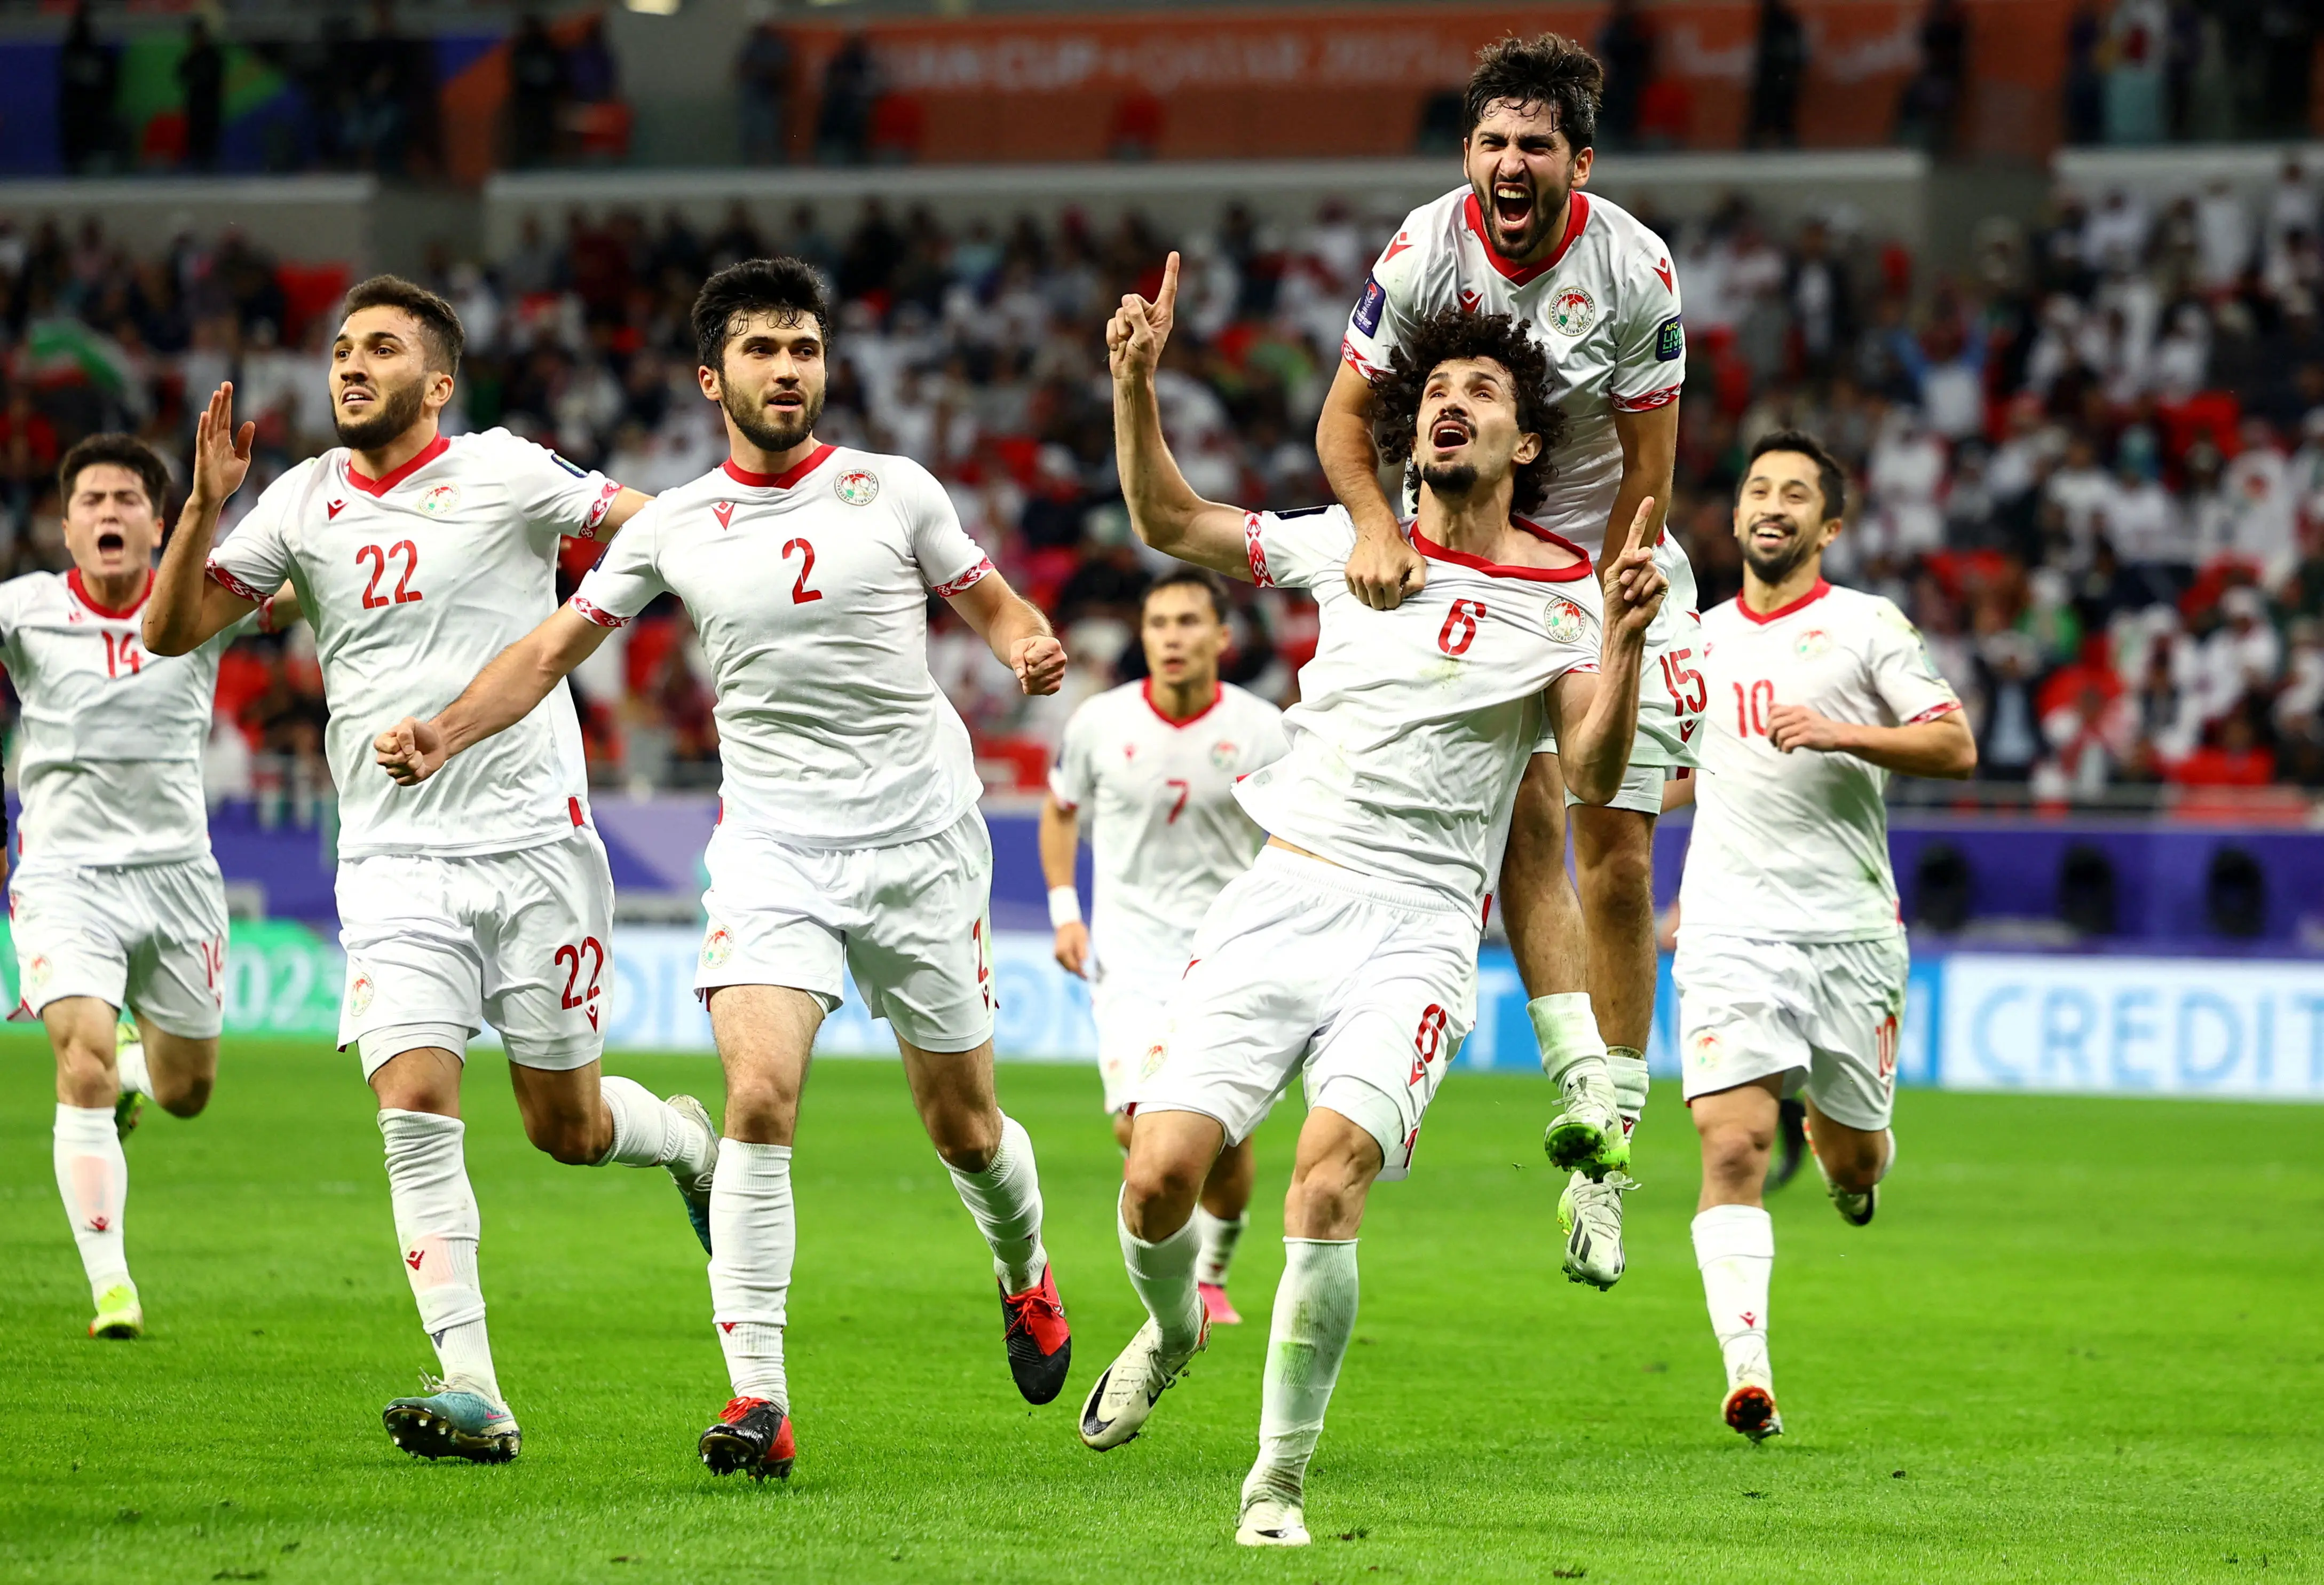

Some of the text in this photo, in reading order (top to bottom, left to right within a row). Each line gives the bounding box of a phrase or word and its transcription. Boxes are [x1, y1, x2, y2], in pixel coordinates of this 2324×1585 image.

[1551, 293, 1562, 329] FEDERATION
[1565, 318, 1592, 334] FOOTBALL
[1665, 321, 1678, 332] AFC
[837, 476, 850, 501] FEDERATION
[855, 488, 876, 503] FOOTBALL
[356, 539, 423, 610] 22
[782, 538, 823, 604] 2
[1438, 598, 1486, 656] 6
[1546, 598, 1564, 627] FEDERATION
[1552, 629, 1578, 641] FOOTBALL
[102, 630, 144, 679] 14
[1660, 648, 1708, 716] 15
[1733, 679, 1774, 738] 10
[1167, 779, 1189, 824] 7
[555, 936, 604, 1010] 22
[1415, 1003, 1447, 1063] 6
[1875, 1015, 1896, 1077] 10
[1971, 981, 2324, 1086] CREDIT
